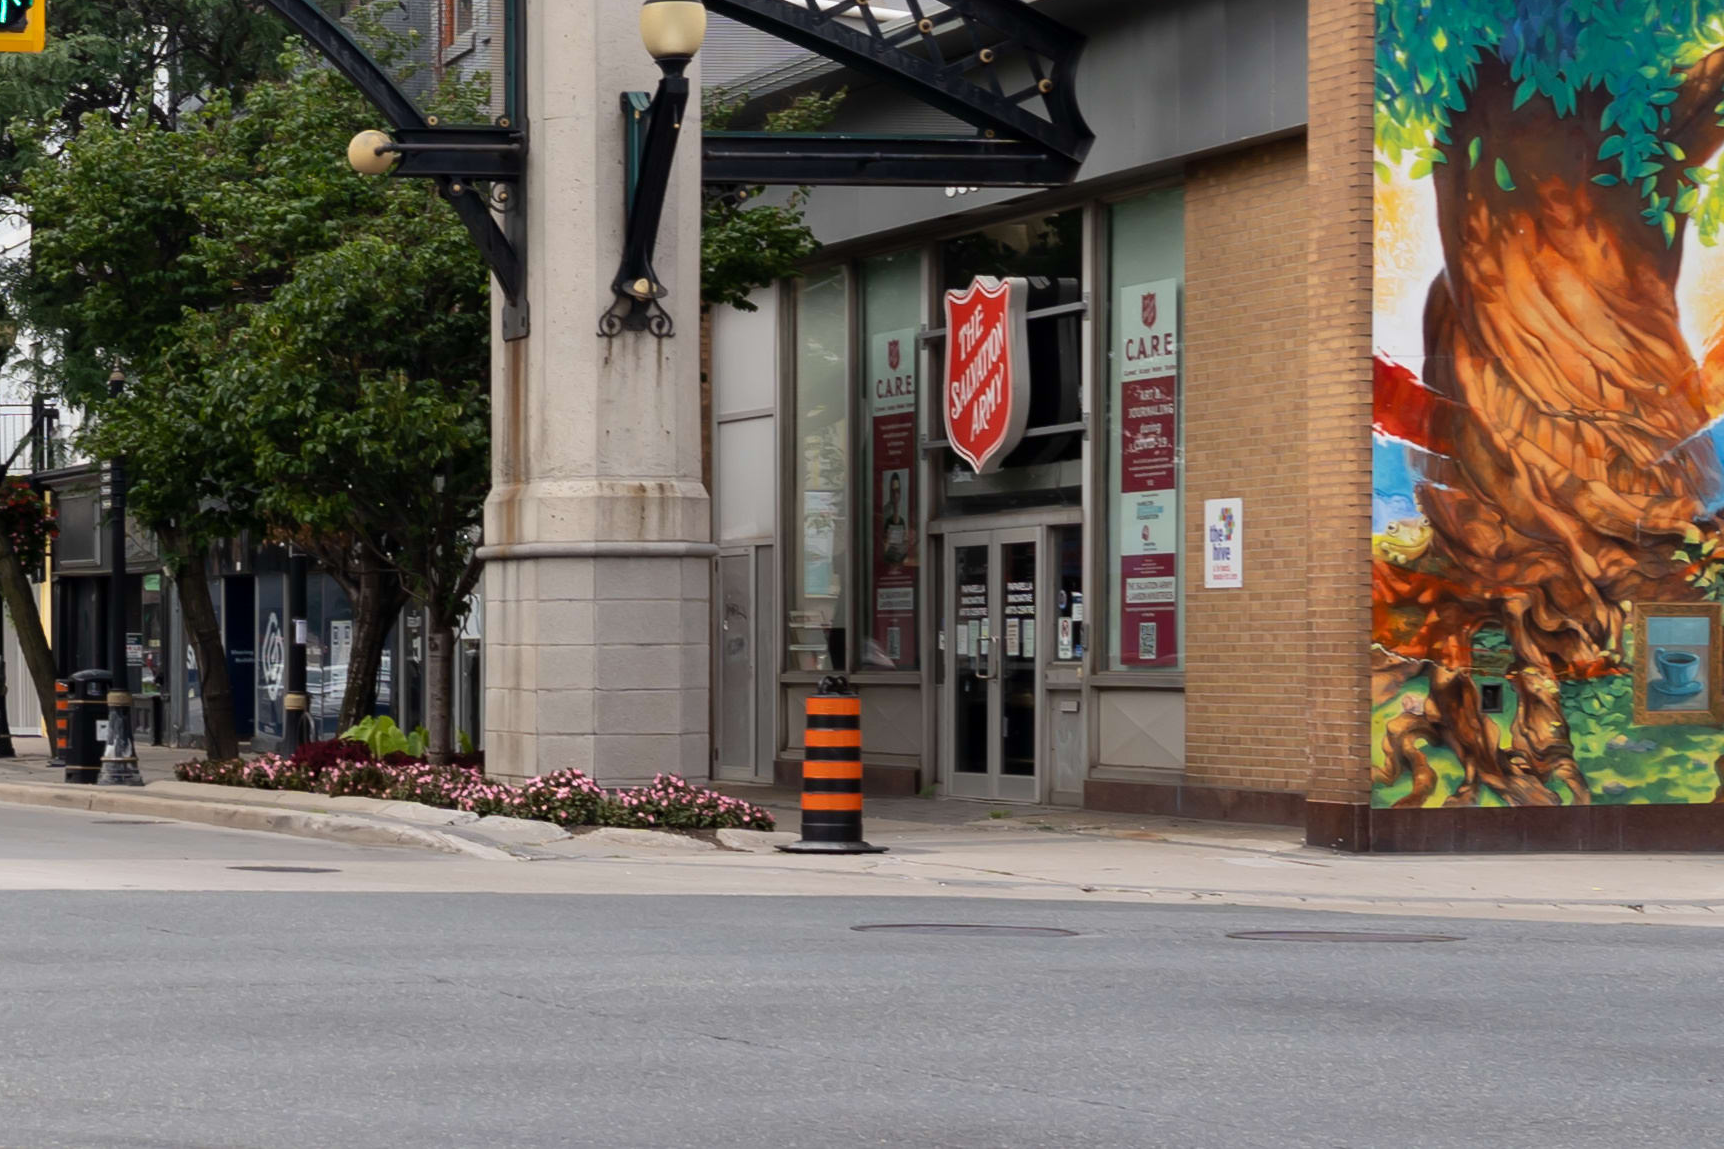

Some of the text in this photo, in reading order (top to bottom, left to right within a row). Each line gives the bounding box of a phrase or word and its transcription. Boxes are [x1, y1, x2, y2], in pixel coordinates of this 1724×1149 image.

[950, 311, 1005, 420] SALVATION
[958, 303, 984, 362] THE
[969, 361, 1005, 443] ARMY
